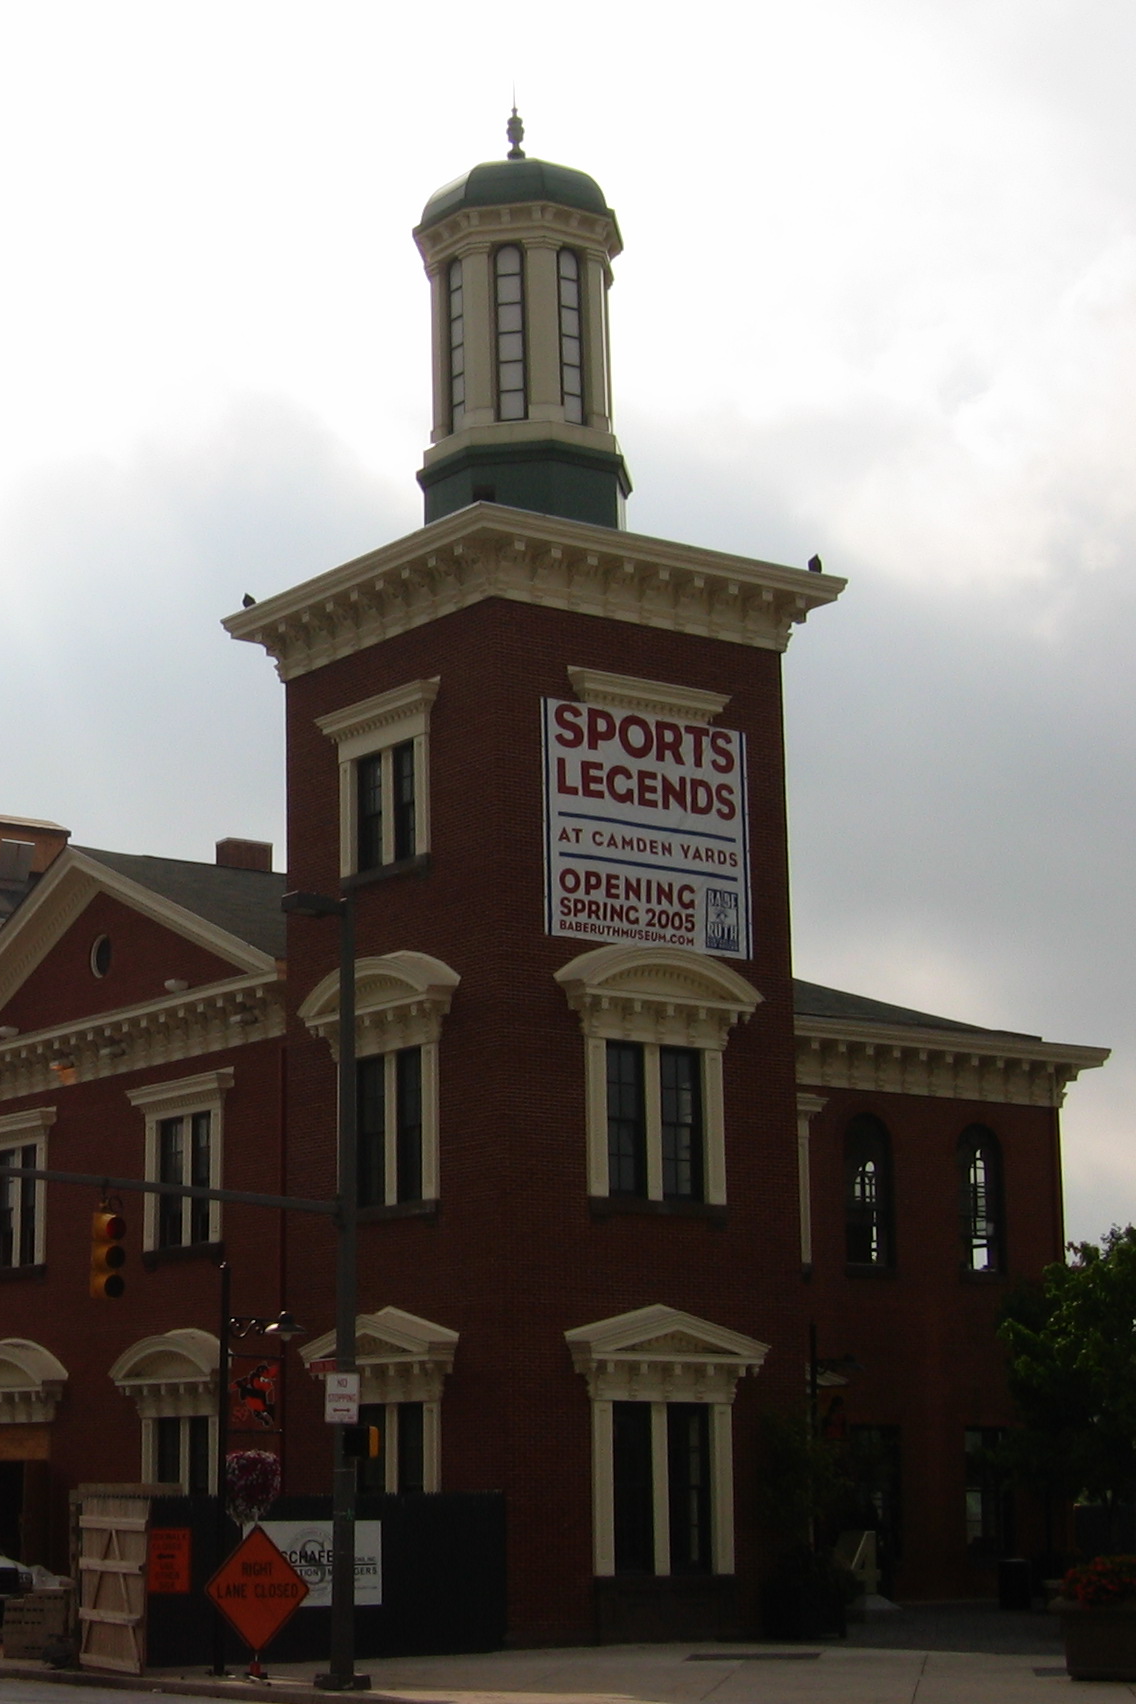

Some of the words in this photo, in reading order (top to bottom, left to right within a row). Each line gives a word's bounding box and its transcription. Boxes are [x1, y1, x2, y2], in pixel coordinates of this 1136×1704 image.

[554, 703, 735, 774] SPORTS
[557, 757, 736, 821] LEGENDS
[558, 826, 583, 843] AT
[592, 831, 673, 857] CAMDEN
[680, 844, 738, 868] YARDS
[559, 867, 696, 910] OPENING
[560, 897, 640, 925] SPRING
[645, 907, 695, 932] 2005
[560, 919, 694, 946] BABERUTHMUSEUM.COM
[708, 922, 738, 940] RUTH
[337, 1378, 347, 1388] NO
[241, 1562, 272, 1576] RIGHT
[217, 1584, 247, 1598] LANE
[255, 1584, 298, 1598] CLOSED
